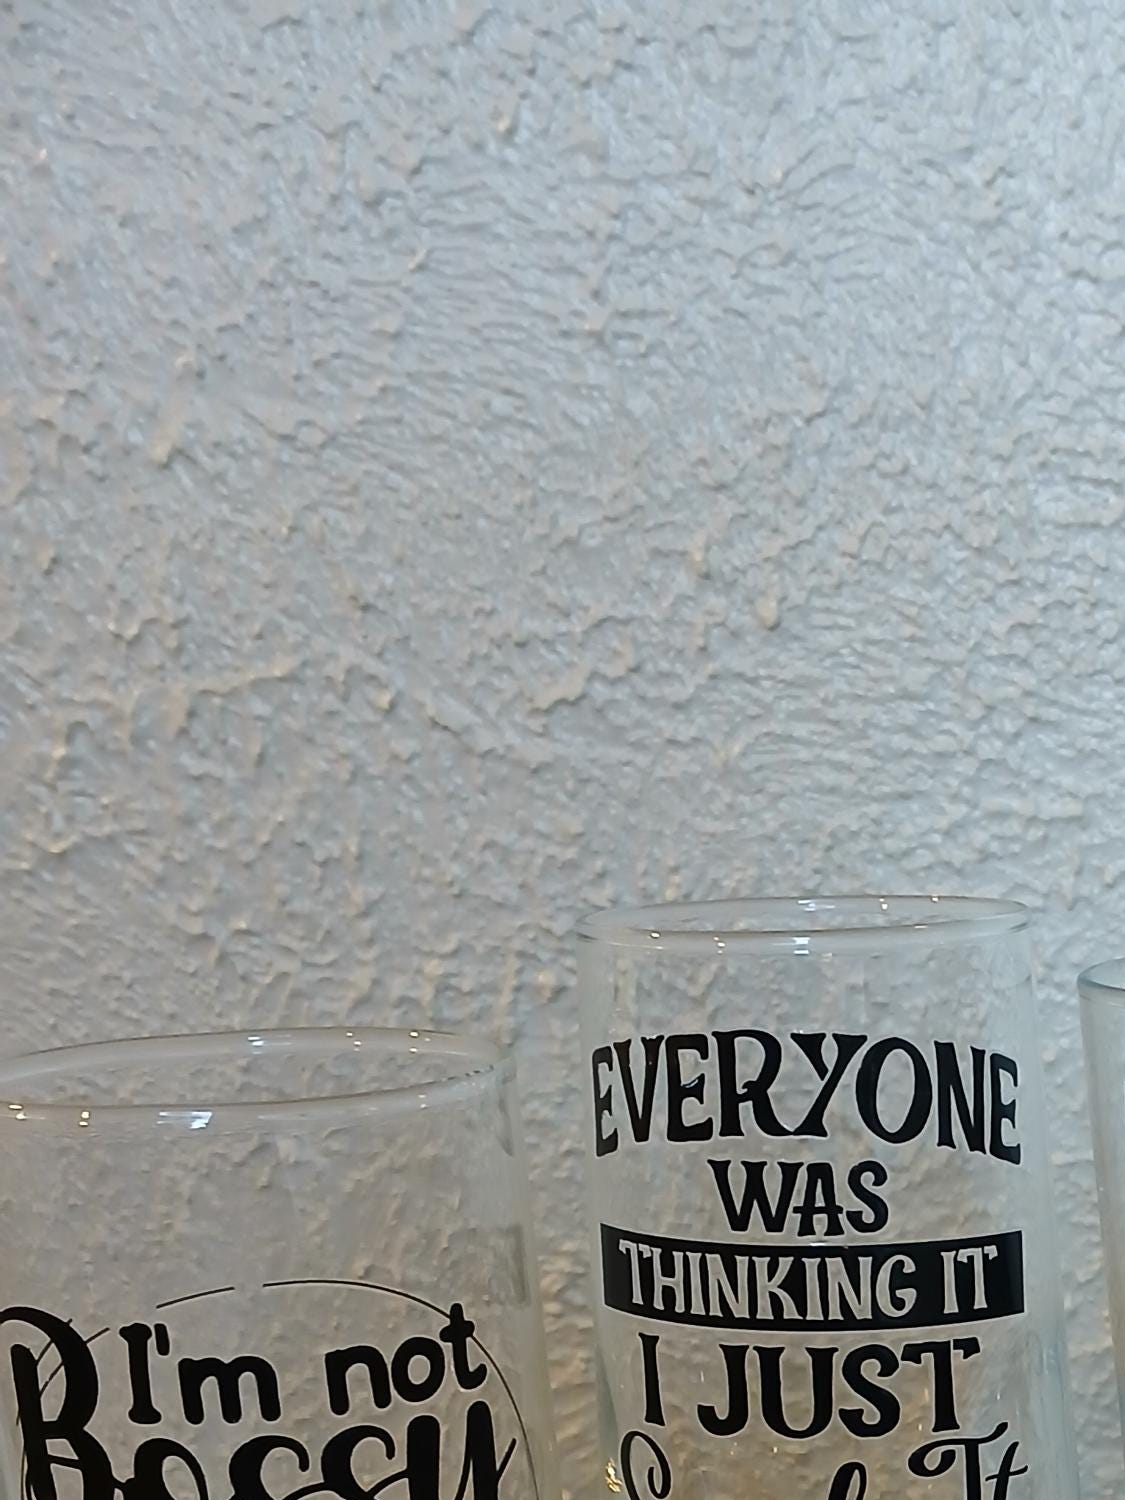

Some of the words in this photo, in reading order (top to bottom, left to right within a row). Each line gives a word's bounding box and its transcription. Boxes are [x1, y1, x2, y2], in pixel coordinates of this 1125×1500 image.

[591, 1029, 1022, 1166] EVERYONE
[707, 1159, 889, 1237] WAS
[618, 1239, 917, 1322] THINKING
[942, 1244, 998, 1315] IT
[119, 1322, 282, 1424] I'm
[325, 1303, 488, 1415] not
[637, 1332, 666, 1427] I
[697, 1336, 981, 1438] JUST
